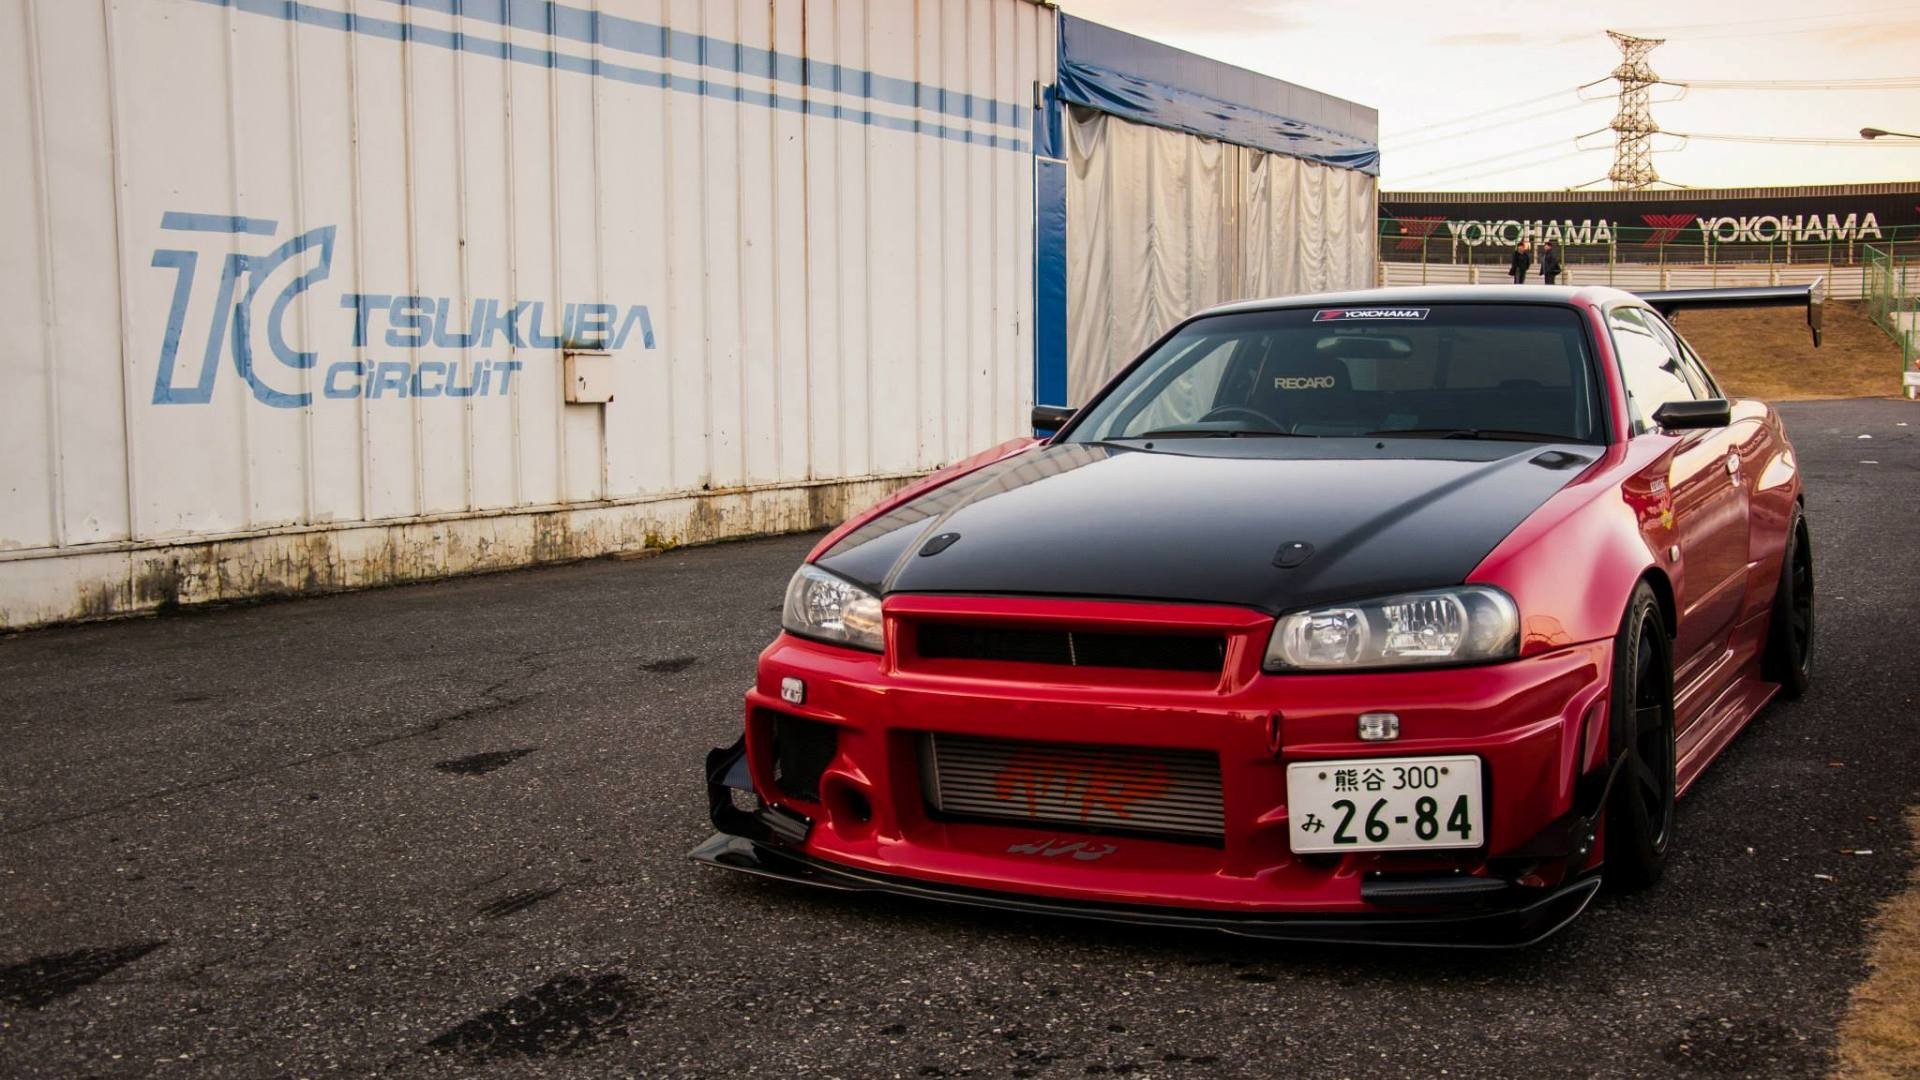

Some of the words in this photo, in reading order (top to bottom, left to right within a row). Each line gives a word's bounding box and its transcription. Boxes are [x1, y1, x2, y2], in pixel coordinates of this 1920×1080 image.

[1447, 218, 1613, 247] YOKOHAMA
[1696, 211, 1882, 243] YOKOHAMA
[151, 210, 337, 409] TC
[340, 293, 656, 350] TSUKUBA
[1344, 309, 1420, 319] YOKOHAMA
[1274, 375, 1336, 390] RECARO
[1334, 768, 1386, 792] 熊谷
[1392, 766, 1439, 790] 300
[1300, 813, 1325, 834] み
[1331, 794, 1472, 844] 26-84
